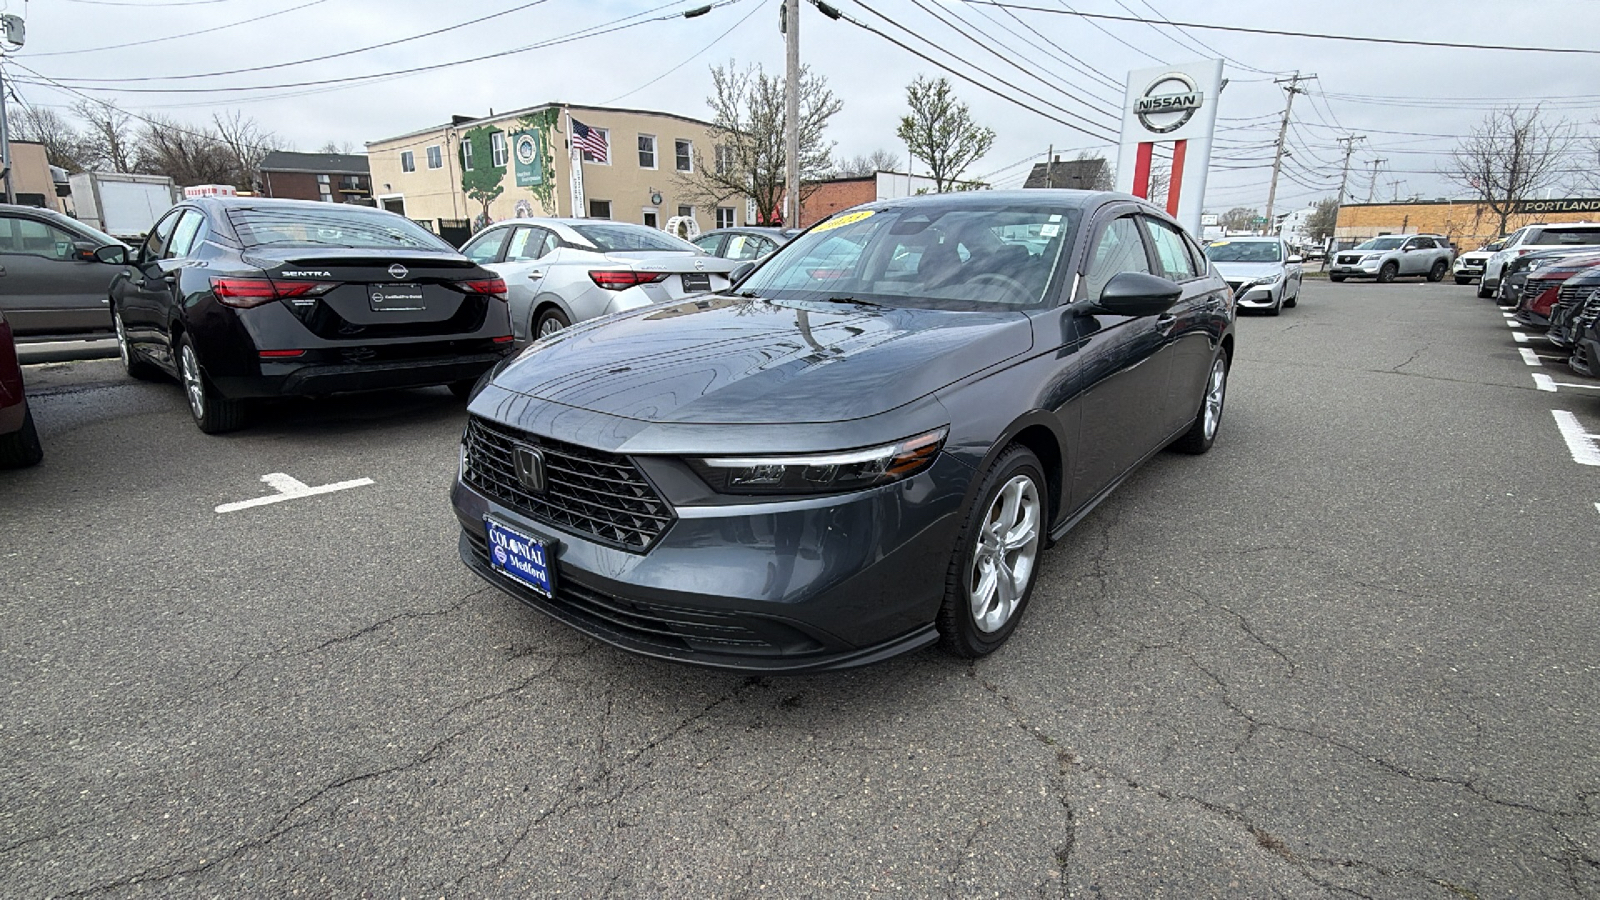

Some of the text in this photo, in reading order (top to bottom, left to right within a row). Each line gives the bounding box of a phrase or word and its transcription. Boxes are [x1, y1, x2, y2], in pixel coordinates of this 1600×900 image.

[1139, 95, 1196, 110] NISSAN
[1524, 201, 1600, 211] PORTLAND
[489, 528, 547, 568] COLONIAL
[509, 554, 547, 583] Medford
